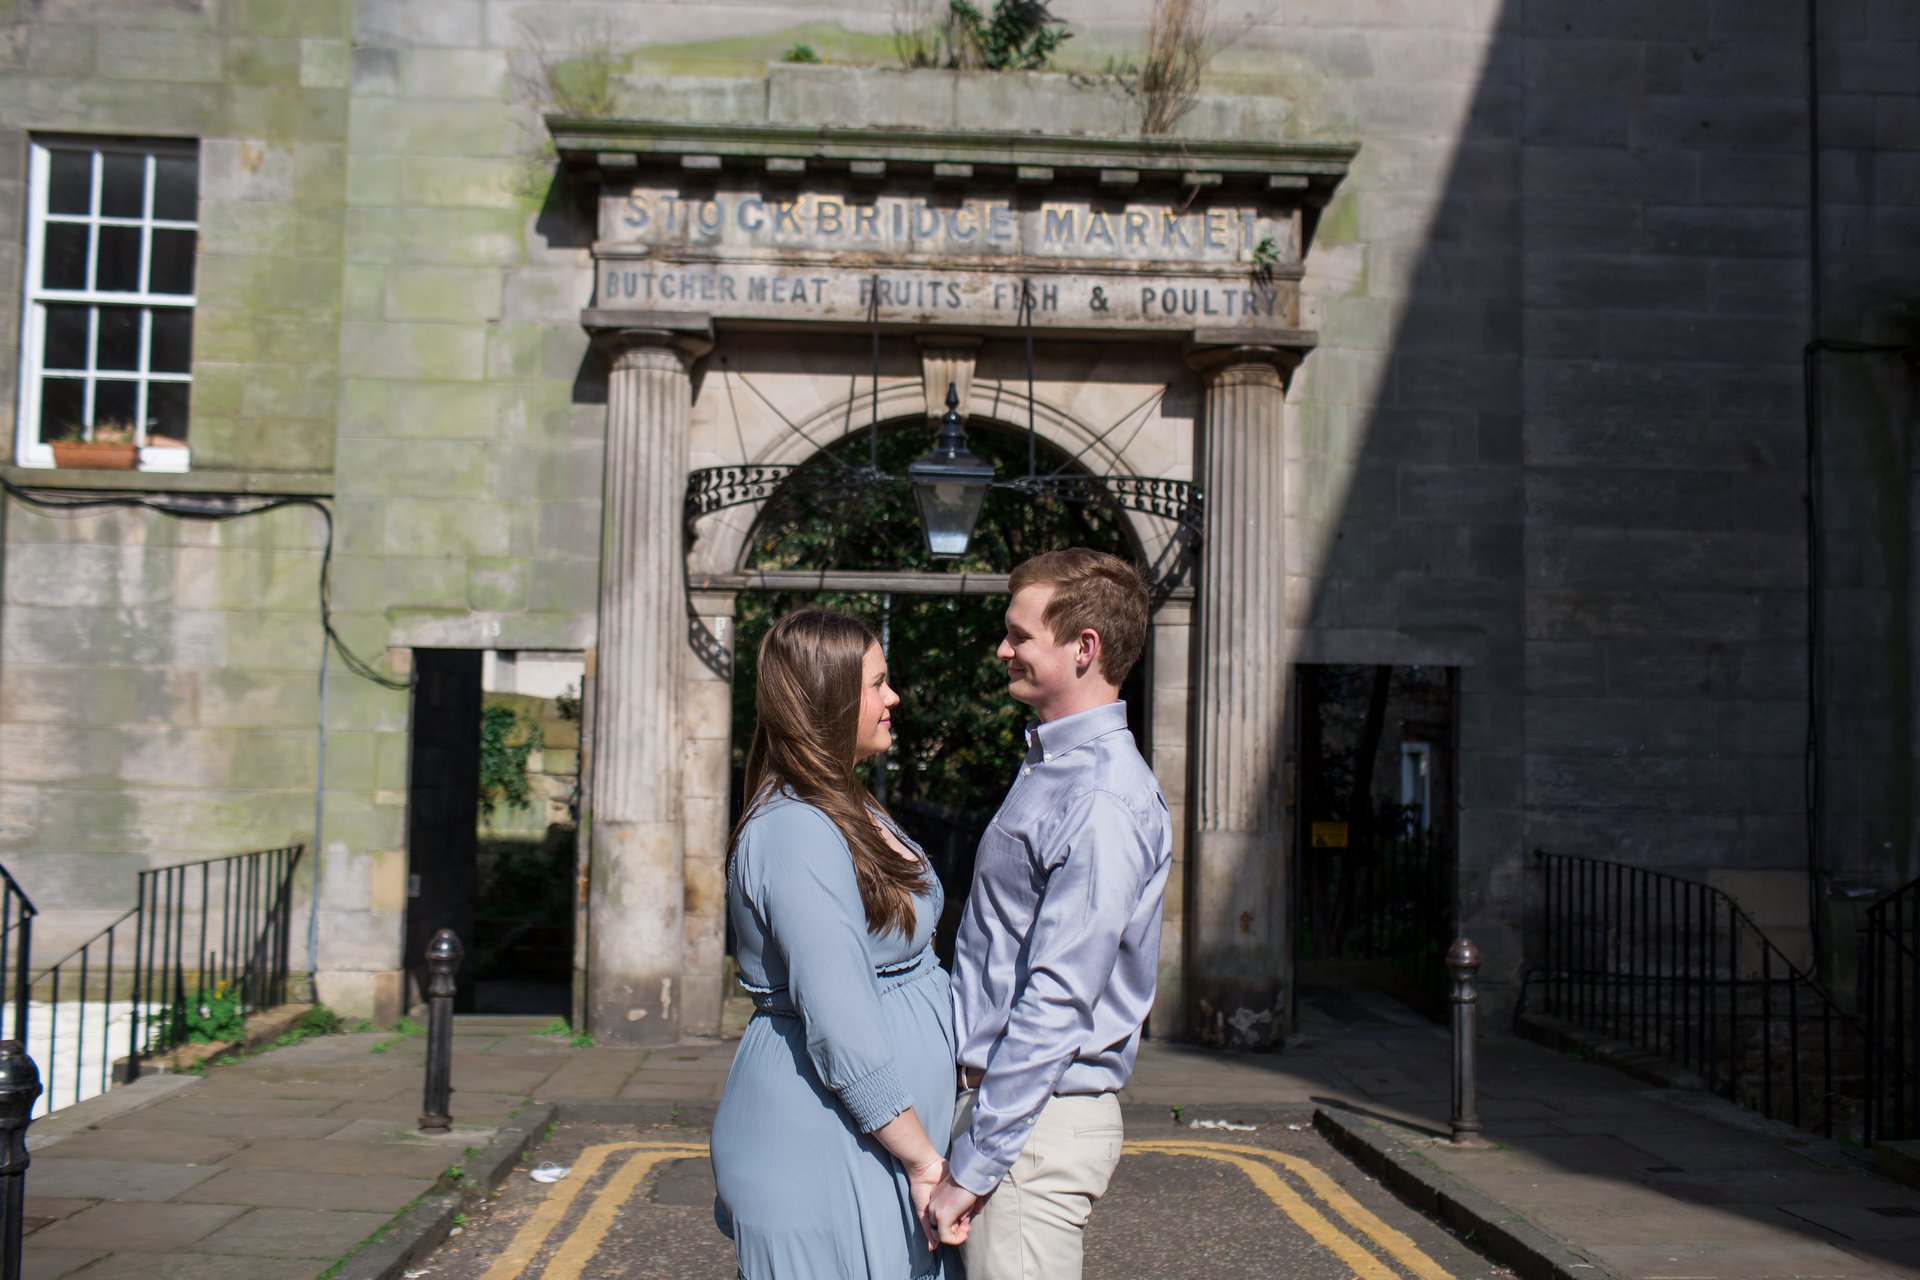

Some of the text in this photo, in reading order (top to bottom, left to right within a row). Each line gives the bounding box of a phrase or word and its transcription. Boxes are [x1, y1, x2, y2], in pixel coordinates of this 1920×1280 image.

[624, 194, 1259, 250] STOCKBRIDGE MARKET
[606, 272, 737, 301] BUTCHER
[748, 276, 828, 304] MEAT
[860, 279, 961, 309] FRUITS
[1089, 286, 1110, 313] &
[1141, 287, 1278, 317] POULTRY
